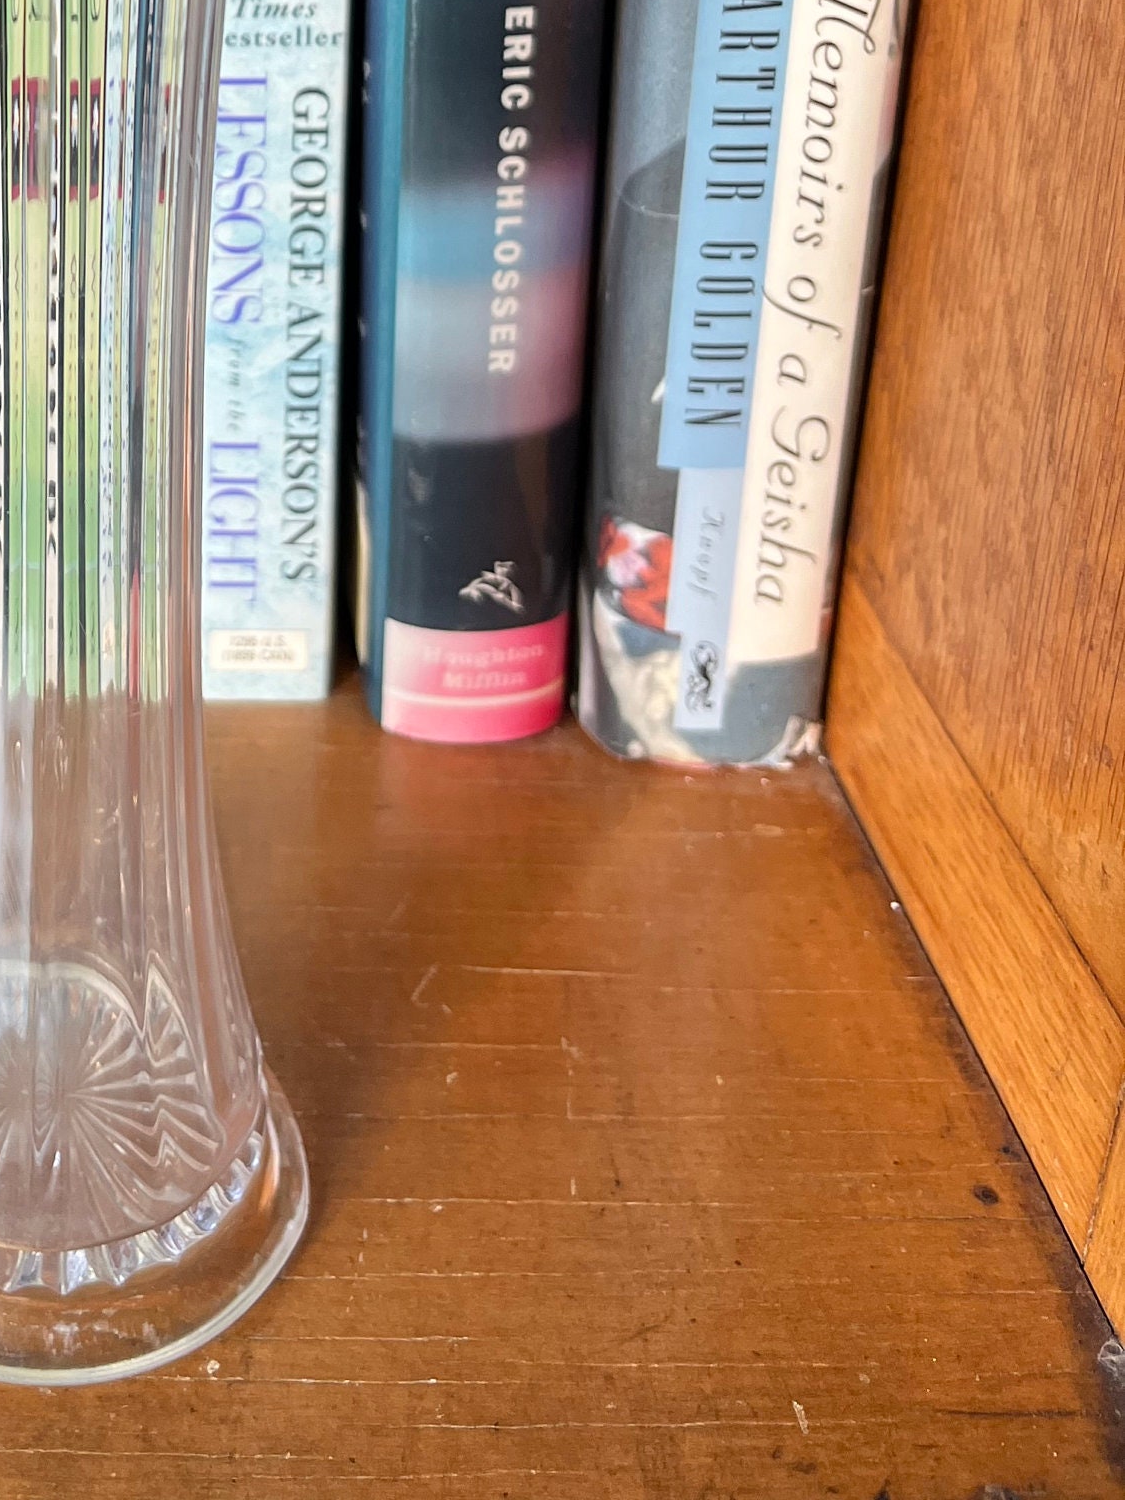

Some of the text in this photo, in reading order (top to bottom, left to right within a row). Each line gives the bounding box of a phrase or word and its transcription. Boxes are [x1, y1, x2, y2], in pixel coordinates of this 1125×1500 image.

[224, 25, 344, 48] estseller
[212, 72, 268, 325] LESSONS
[488, 5, 537, 374] ERIC SCHLOSSER
[278, 86, 331, 582] GEORGE ANDERSON'S
[684, 240, 759, 428] GOLDEN
[761, 275, 843, 339] of
[778, 353, 807, 386] a
[207, 440, 261, 611] LIGHT
[754, 405, 831, 606] Geisha
